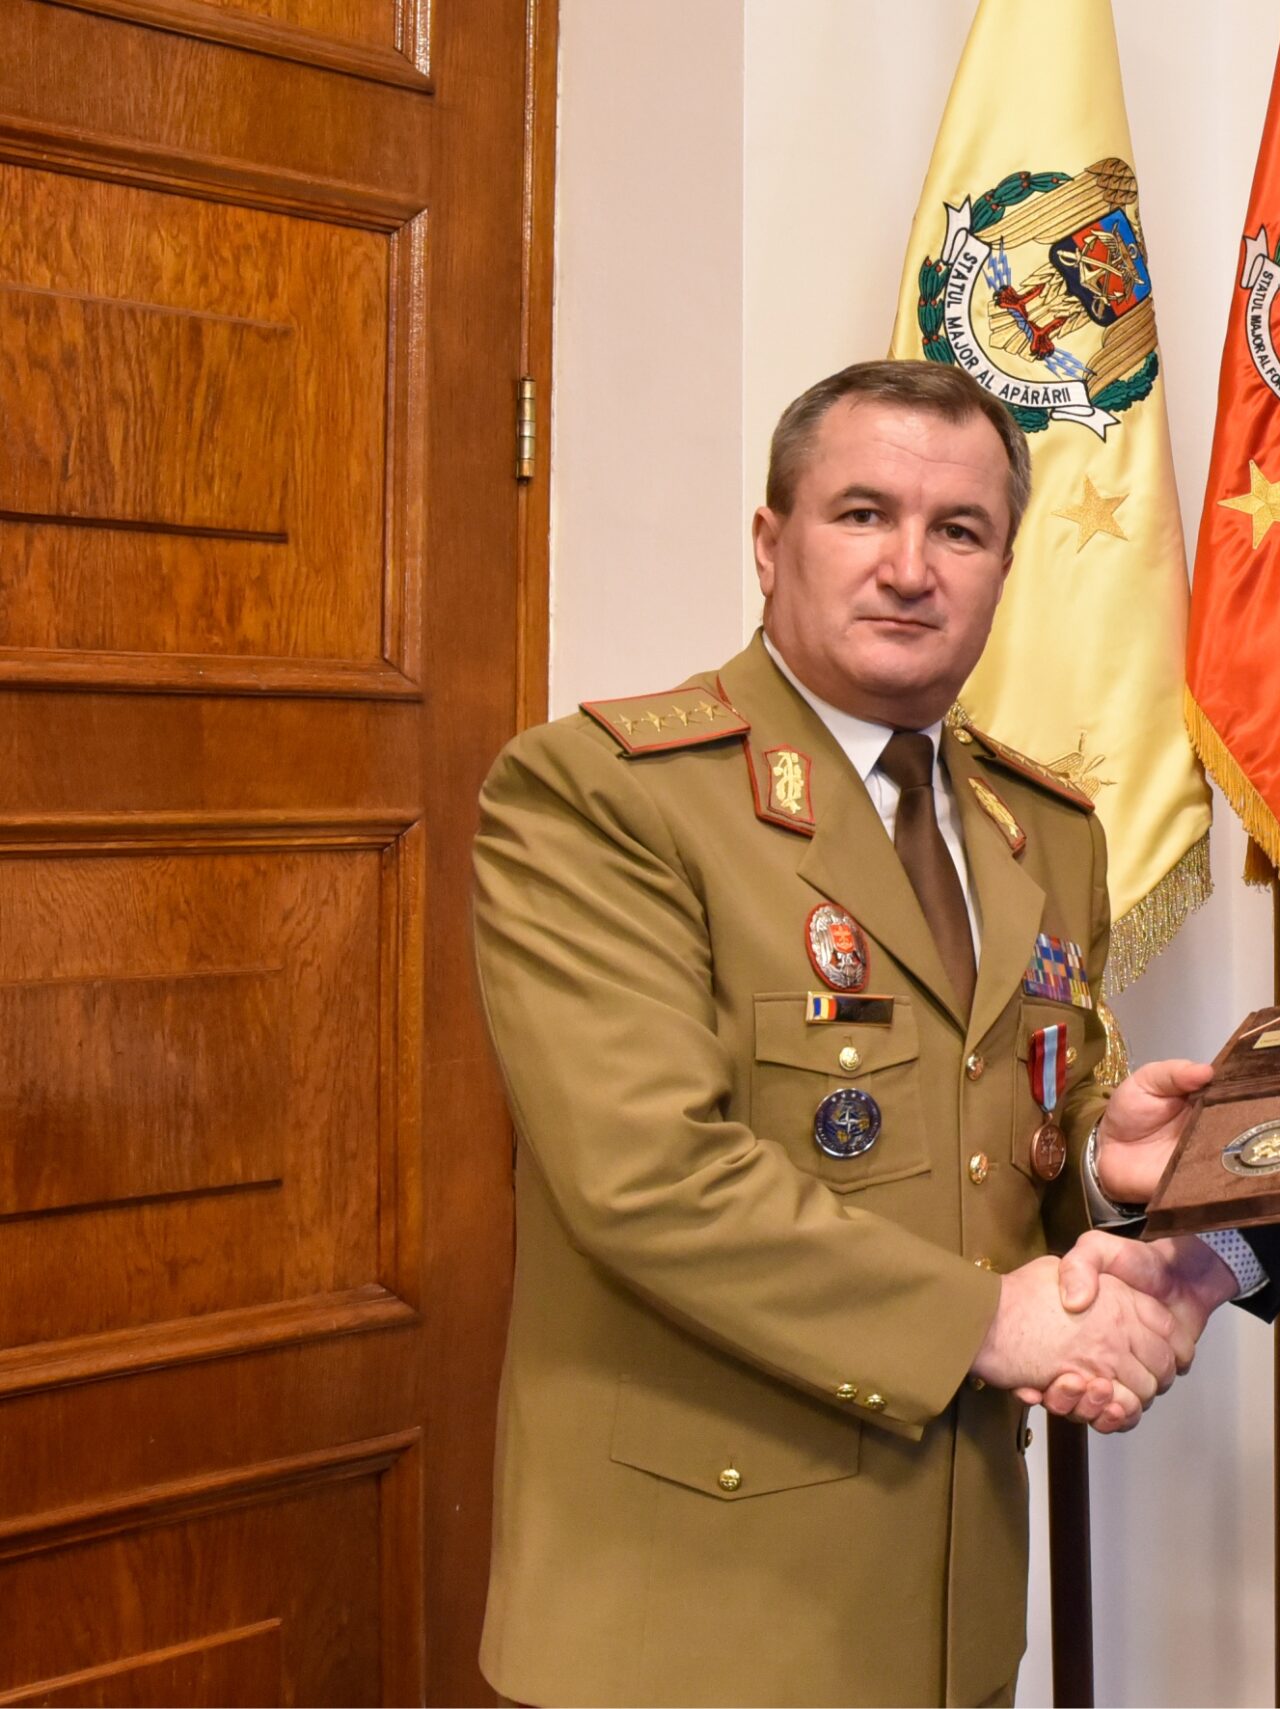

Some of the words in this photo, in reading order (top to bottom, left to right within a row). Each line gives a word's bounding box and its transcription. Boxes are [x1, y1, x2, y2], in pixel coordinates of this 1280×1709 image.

[947, 252, 978, 308] STATUL
[1251, 271, 1274, 312] STATUL
[947, 316, 979, 370] MAJOR
[1251, 315, 1266, 354] MAJOR
[976, 370, 994, 389] AL
[1257, 355, 1270, 371] AL
[998, 383, 1071, 405] APĂRĂRII
